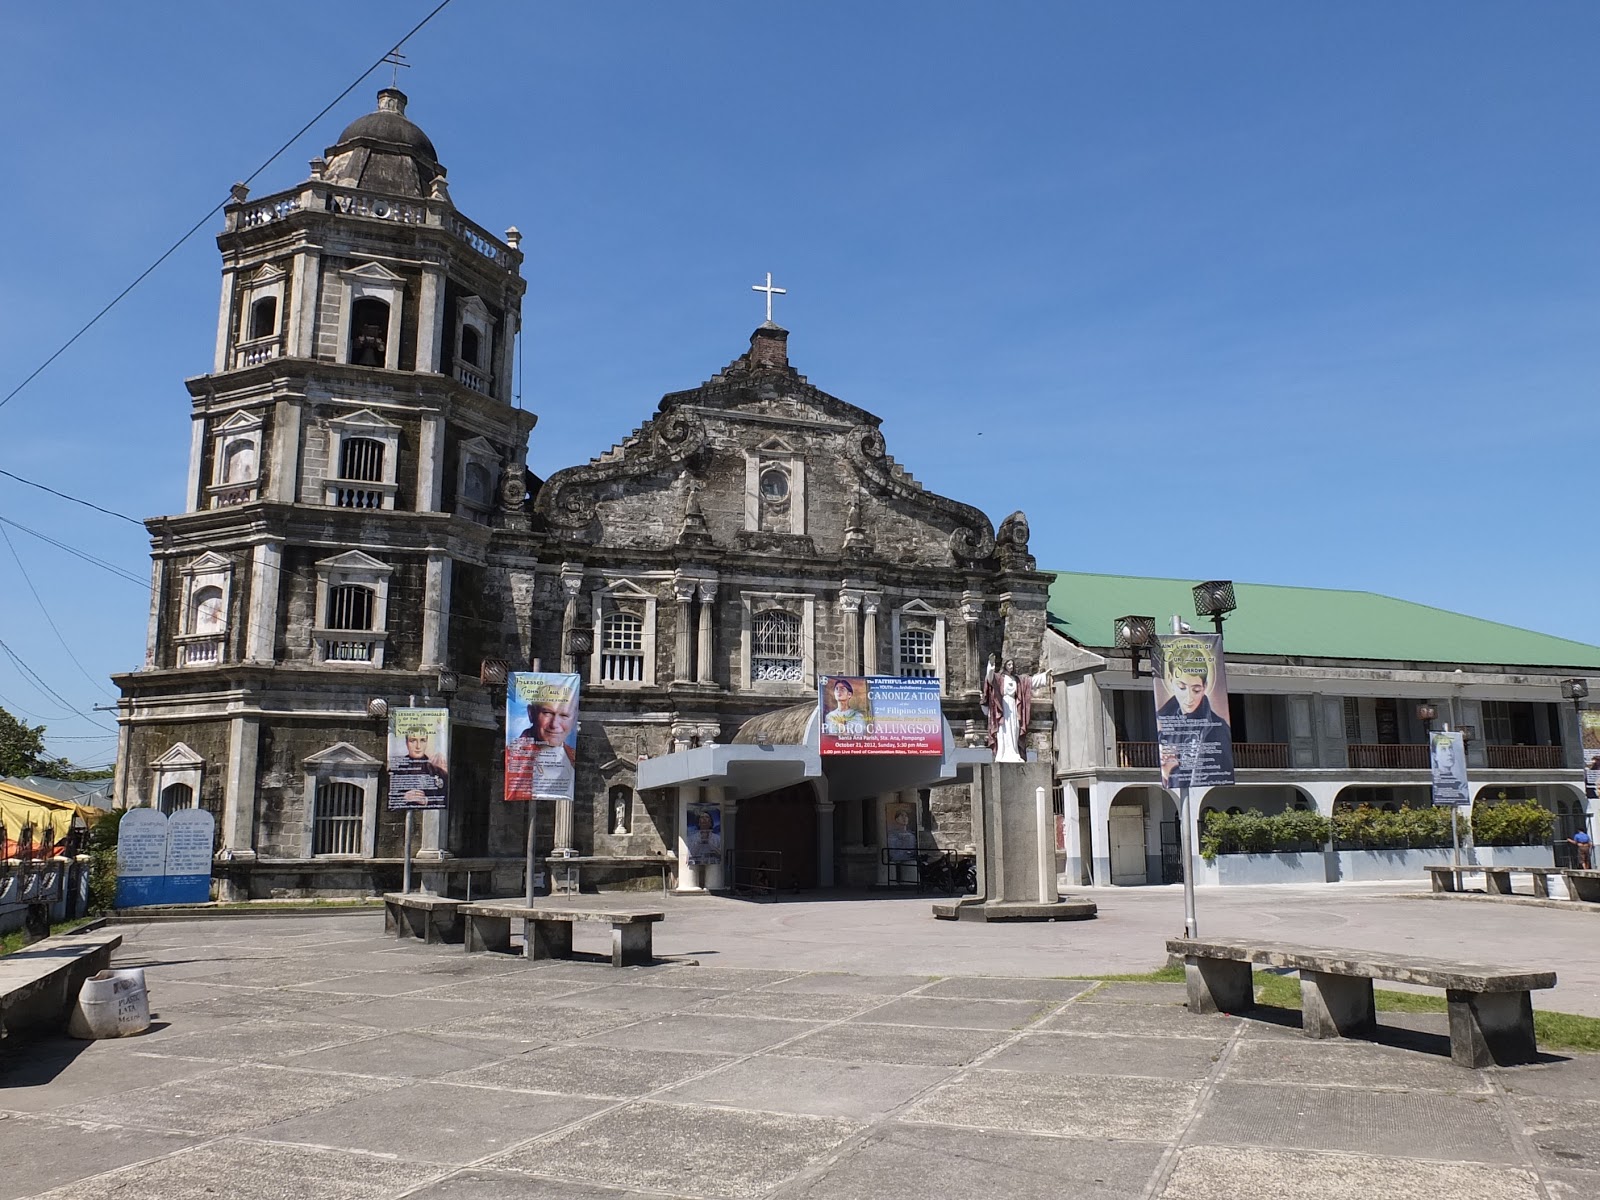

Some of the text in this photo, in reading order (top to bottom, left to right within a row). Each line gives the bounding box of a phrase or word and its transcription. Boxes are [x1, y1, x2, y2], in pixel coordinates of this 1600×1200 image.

[1175, 663, 1207, 678] SORROWS
[515, 676, 544, 685] BLESSED
[519, 686, 539, 697] JOHN
[867, 691, 940, 701] CANONIZATION
[874, 706, 936, 716] 2nd Filipino Saint
[821, 723, 940, 734] PEDRO CALUNGSOD
